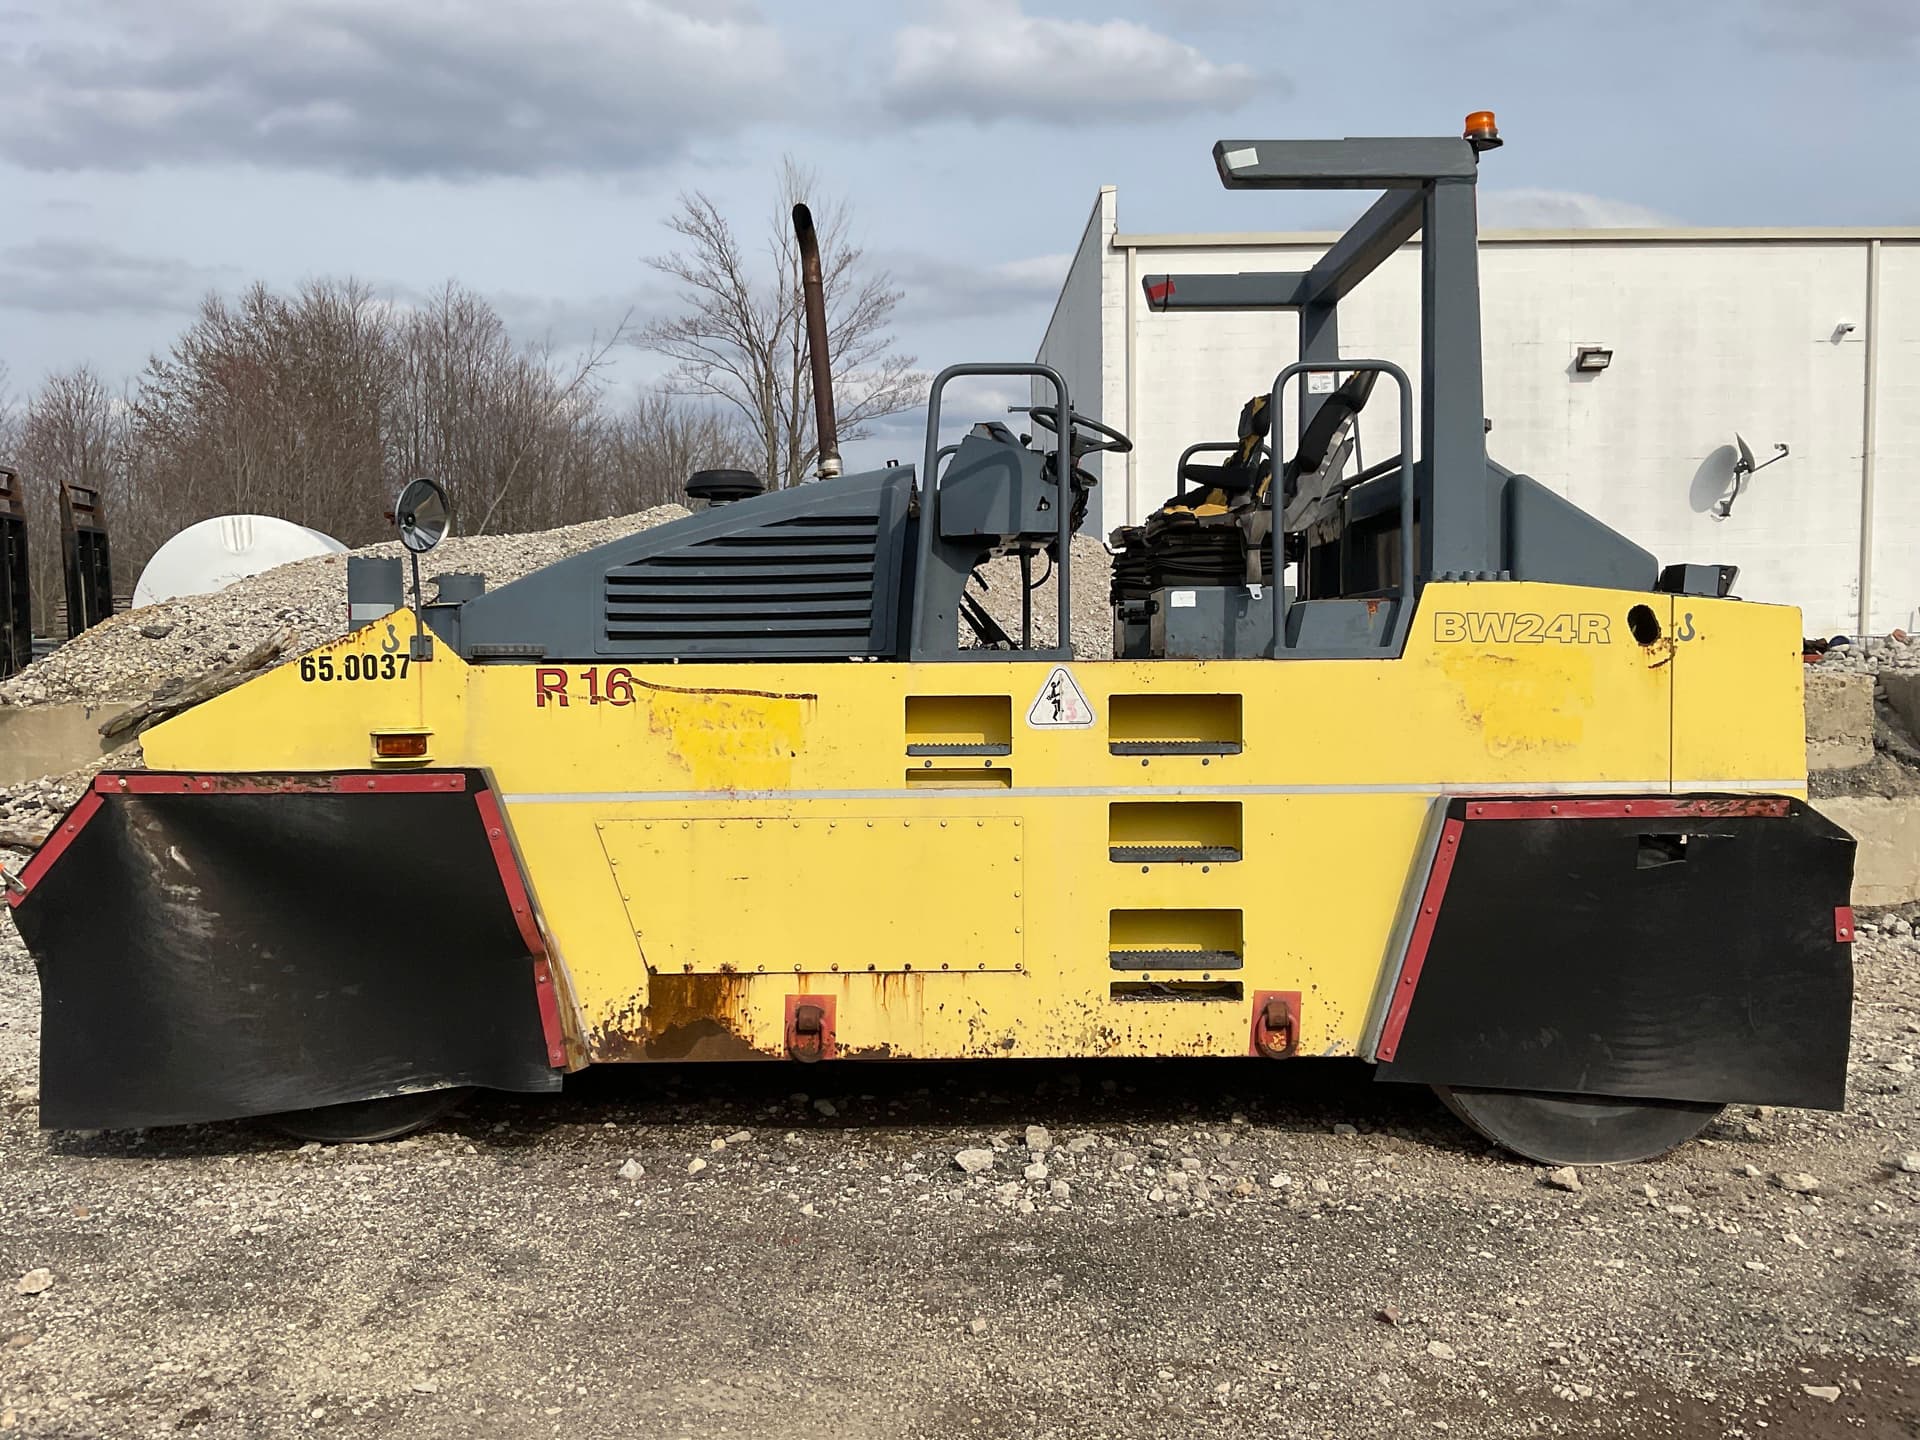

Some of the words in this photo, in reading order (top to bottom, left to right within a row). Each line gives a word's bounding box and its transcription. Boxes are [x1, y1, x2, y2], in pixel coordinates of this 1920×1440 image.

[1434, 612, 1611, 644] BW24R
[300, 654, 410, 682] 65.0037
[536, 668, 570, 707] R
[580, 667, 636, 706] 16
